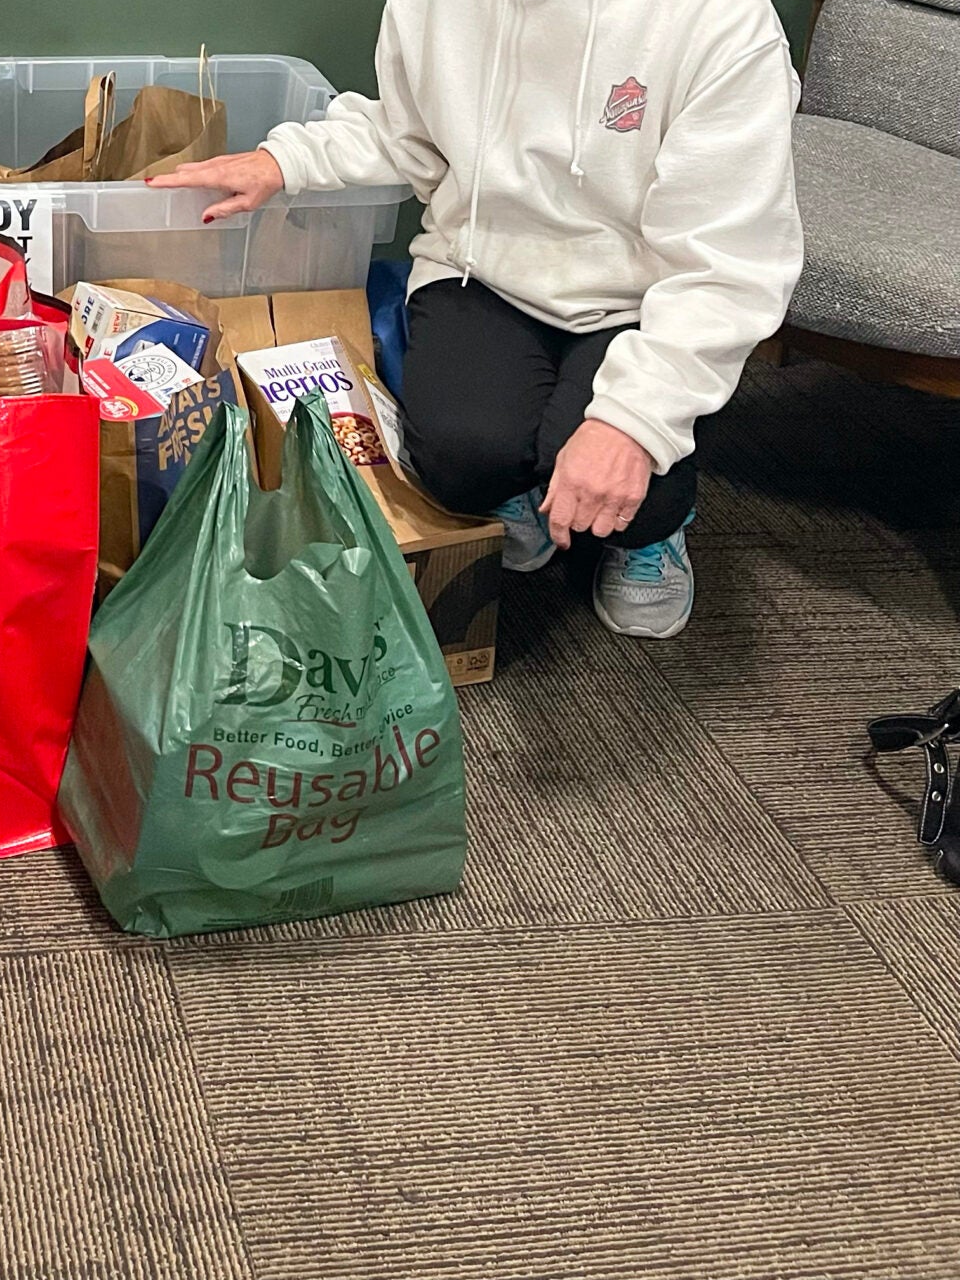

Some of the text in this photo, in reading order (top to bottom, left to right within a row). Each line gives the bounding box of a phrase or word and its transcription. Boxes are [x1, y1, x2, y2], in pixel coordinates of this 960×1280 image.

[263, 357, 342, 381] Multi Grain
[294, 693, 352, 722] Fresh
[213, 728, 267, 744] Better
[273, 731, 324, 757] Food,
[331, 735, 378, 758] Better
[184, 724, 440, 809] Reusable
[260, 806, 369, 850] Bag
